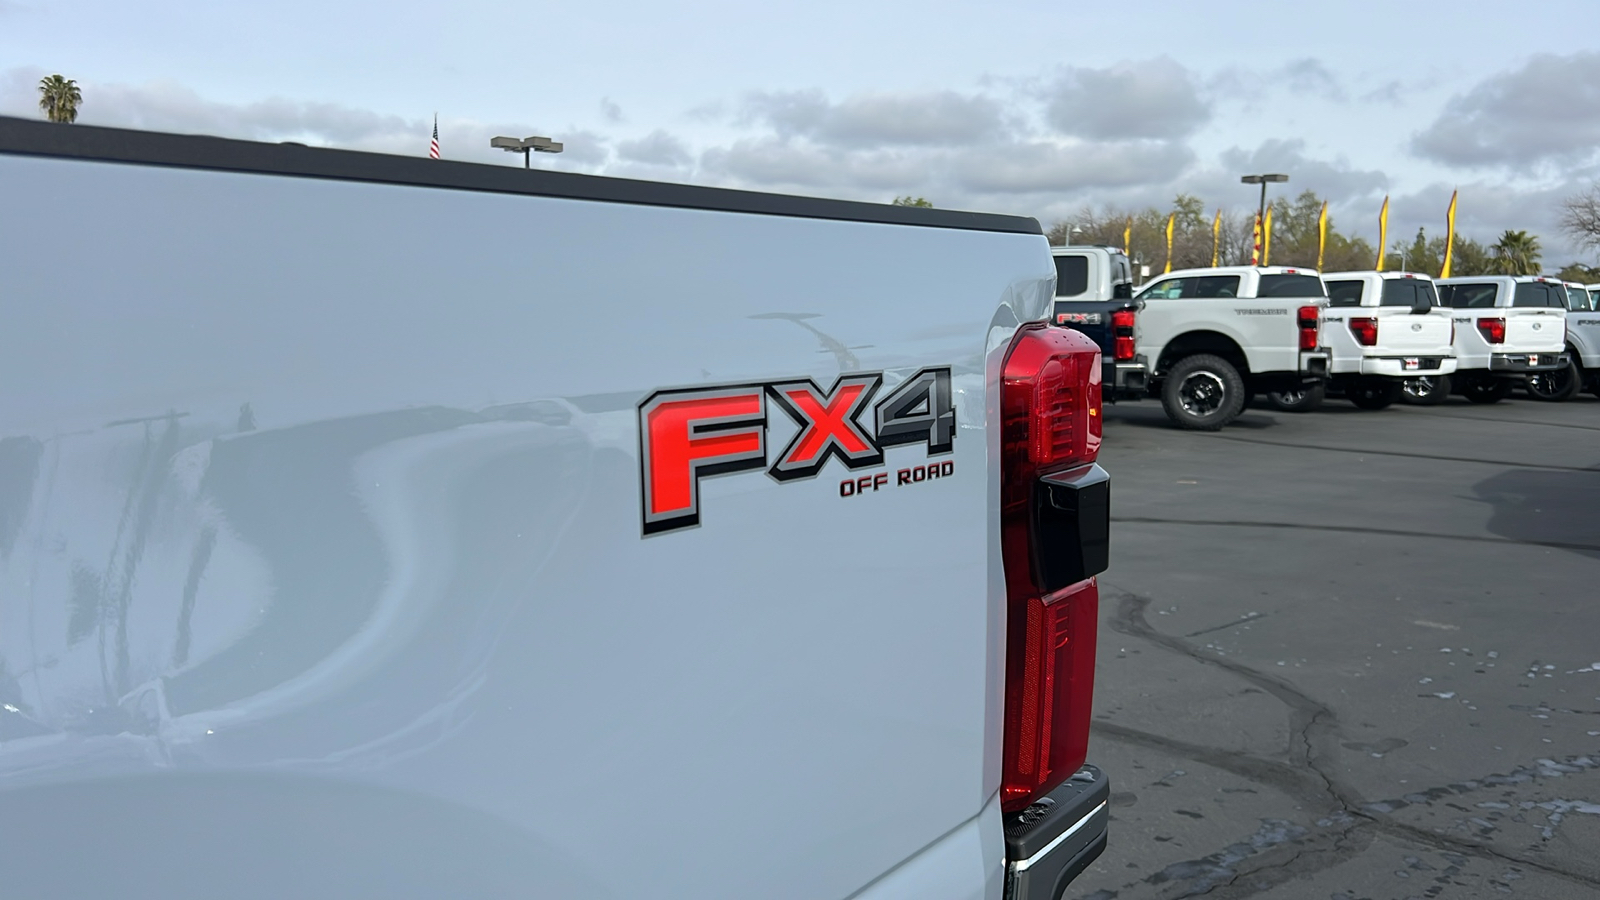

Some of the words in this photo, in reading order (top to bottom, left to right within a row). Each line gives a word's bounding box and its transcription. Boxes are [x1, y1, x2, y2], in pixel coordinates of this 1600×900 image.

[1057, 313, 1101, 324] FX4
[636, 364, 956, 539] FX4
[840, 472, 888, 498] OFF
[897, 460, 954, 487] ROAD
